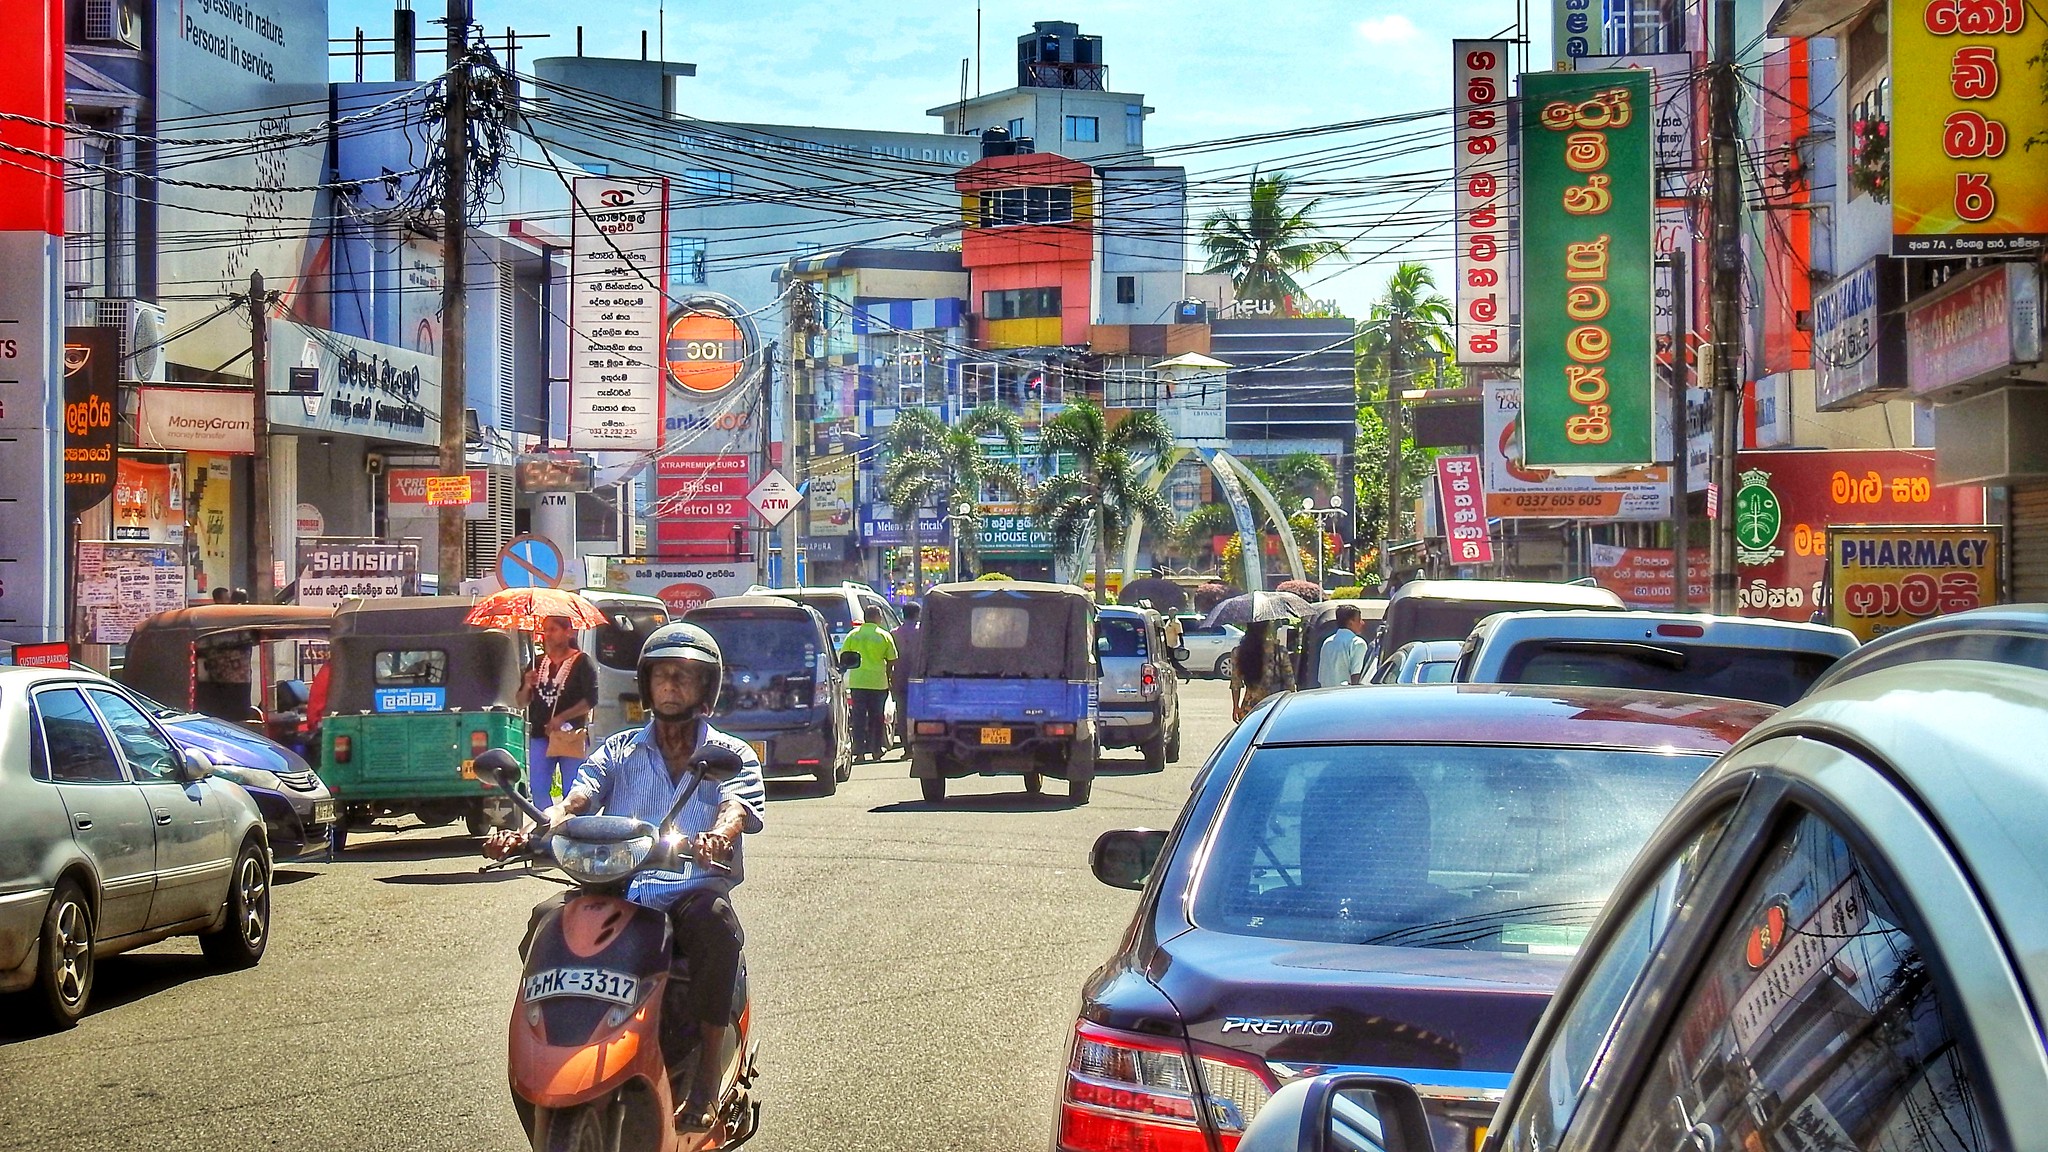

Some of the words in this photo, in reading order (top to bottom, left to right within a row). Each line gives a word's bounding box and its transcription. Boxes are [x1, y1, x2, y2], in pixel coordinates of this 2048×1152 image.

[245, 2, 254, 31] in
[256, 15, 286, 48] nature.
[186, 14, 228, 61] Personal
[231, 37, 240, 66] in
[241, 49, 276, 84] service.
[870, 144, 971, 164] BUILDING
[168, 415, 250, 432] MoneyGram
[683, 481, 723, 492] Diesel
[1891, 476, 1931, 503] සහ
[541, 495, 567, 506] ATM
[760, 498, 789, 510] ATM
[1516, 494, 1547, 507] 0337
[1551, 494, 1575, 506] 605
[1578, 493, 1602, 506] 605
[675, 503, 713, 515] Petrol
[716, 503, 732, 515] 92
[994, 532, 1028, 543] HOUSE
[1841, 539, 1989, 568] PHARMACY
[19, 656, 46, 667] CUSTOMER
[46, 652, 69, 665] PARKING
[541, 971, 635, 999] MK-3317
[1221, 1016, 1334, 1037] PREMIO
